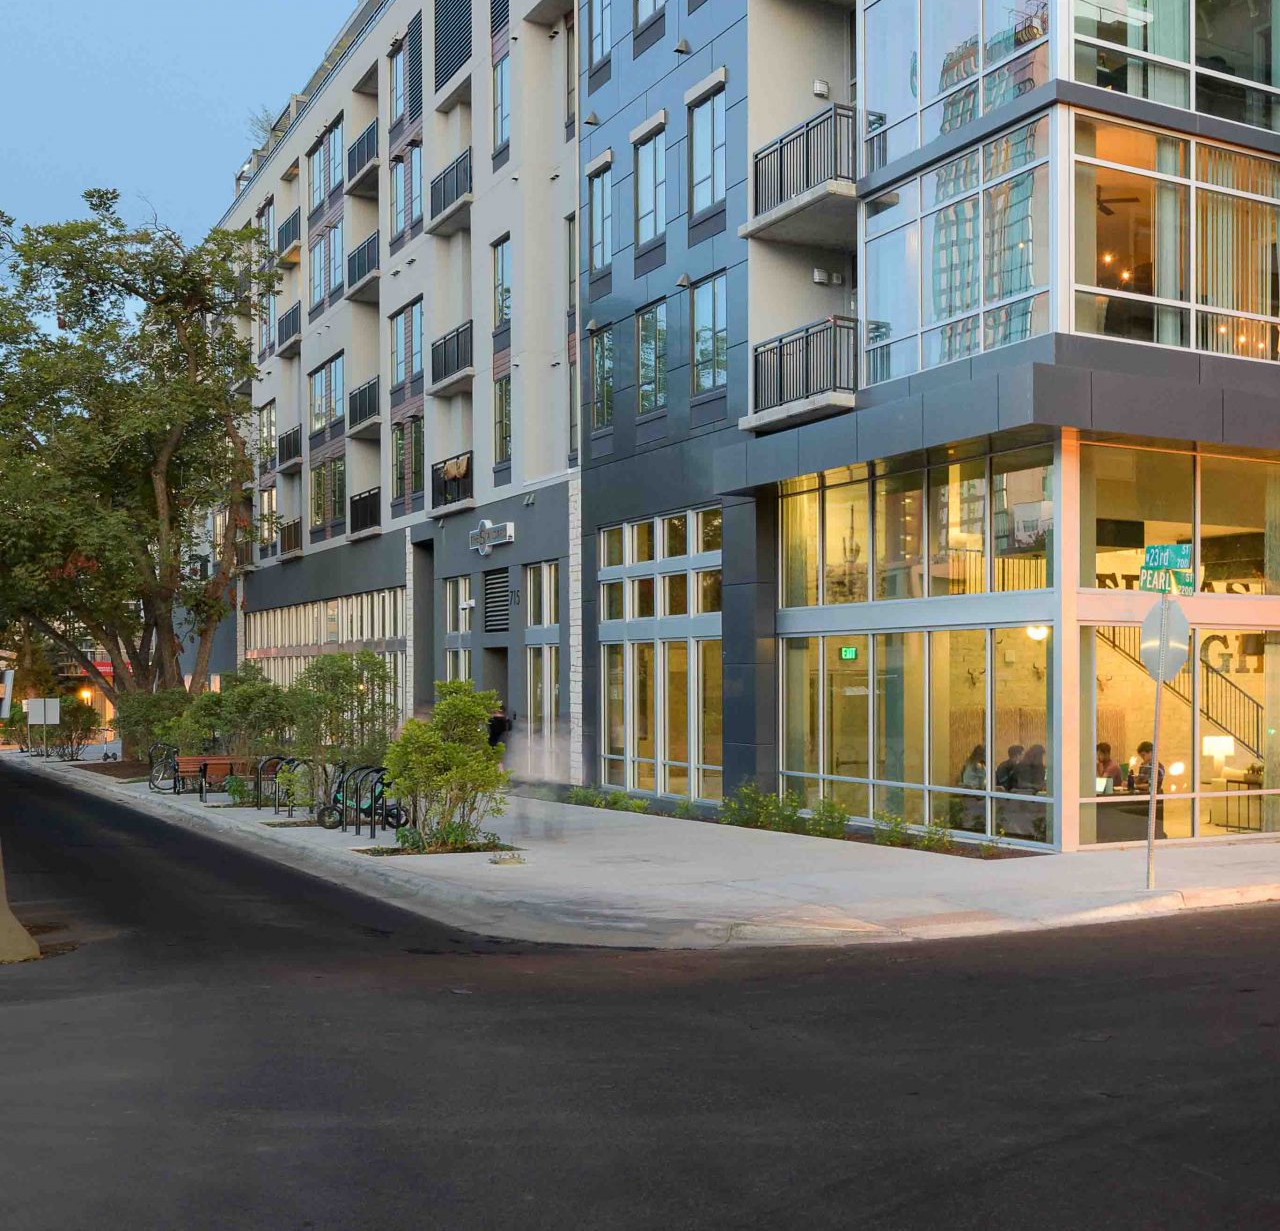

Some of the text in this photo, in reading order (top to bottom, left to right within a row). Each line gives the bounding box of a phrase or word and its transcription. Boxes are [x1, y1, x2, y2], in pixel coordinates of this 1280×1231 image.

[1149, 549, 1169, 566] 23rd
[1182, 545, 1189, 555] ST
[1140, 570, 1171, 590] PEARL
[1185, 573, 1193, 582] ST
[510, 589, 520, 606] 715
